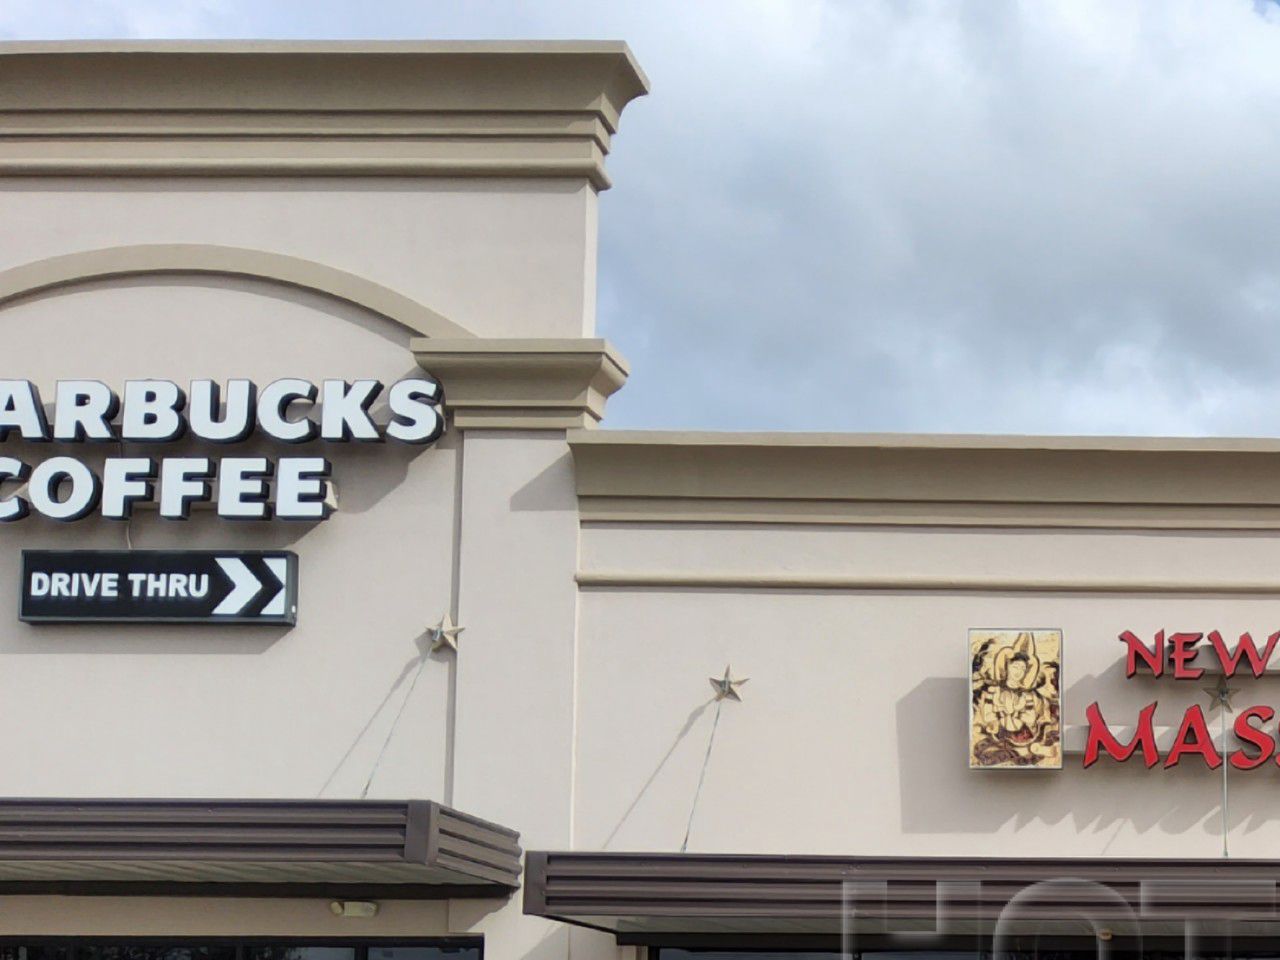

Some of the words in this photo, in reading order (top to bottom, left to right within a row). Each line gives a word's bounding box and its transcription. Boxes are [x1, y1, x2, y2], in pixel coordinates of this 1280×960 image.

[0, 379, 443, 443] ARBUCKS
[30, 572, 118, 598] DRIVE
[128, 572, 209, 598] THRU
